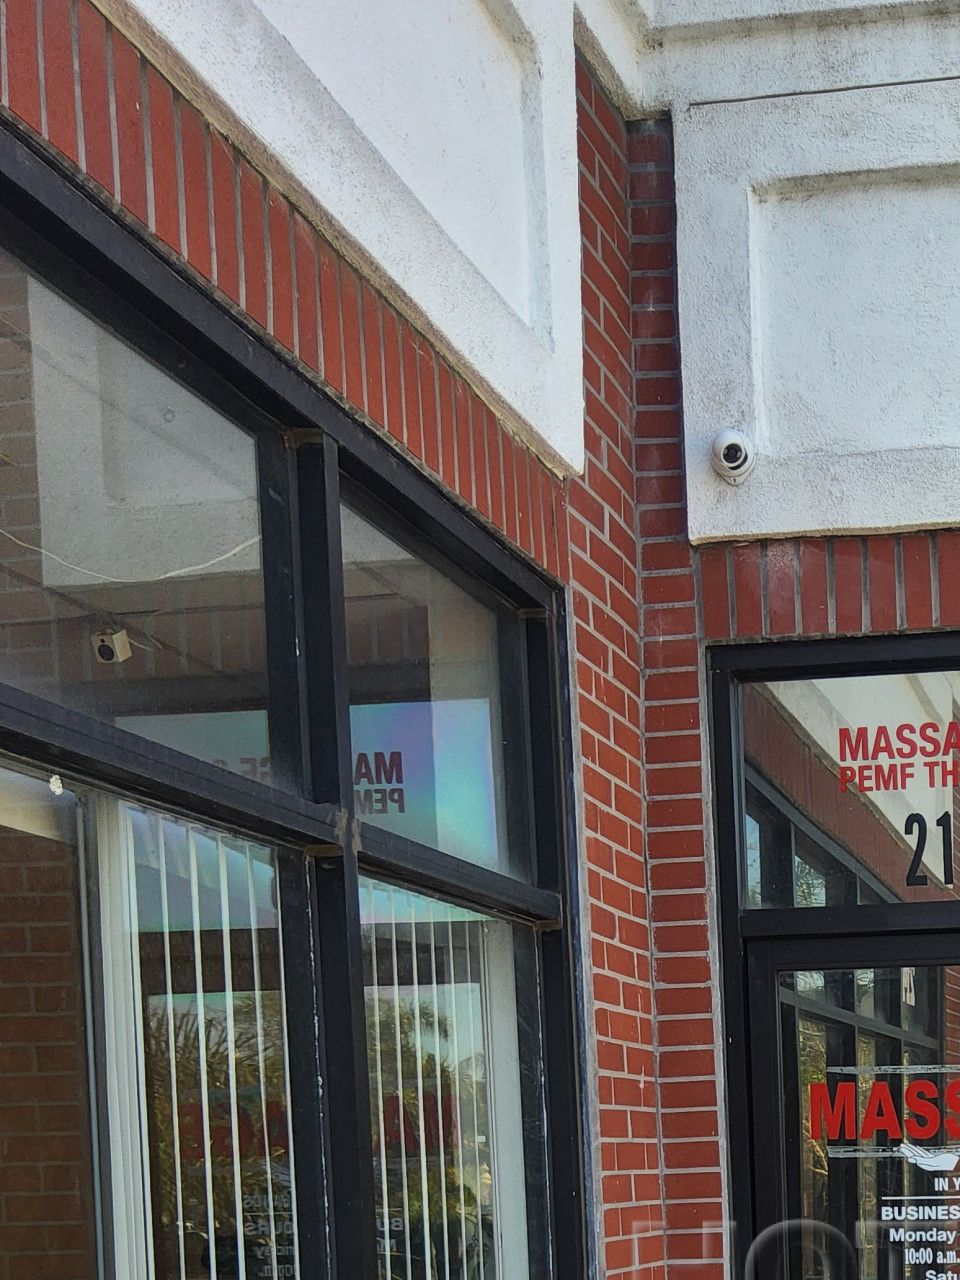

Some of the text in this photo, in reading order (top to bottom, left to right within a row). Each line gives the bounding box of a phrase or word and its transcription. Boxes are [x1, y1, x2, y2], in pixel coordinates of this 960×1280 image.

[839, 762, 915, 793] PEMF
[934, 1177, 948, 1191] IN
[889, 1228, 956, 1244] Monday
[904, 1247, 933, 1265] 10:00
[936, 1249, 960, 1264] a.m.
